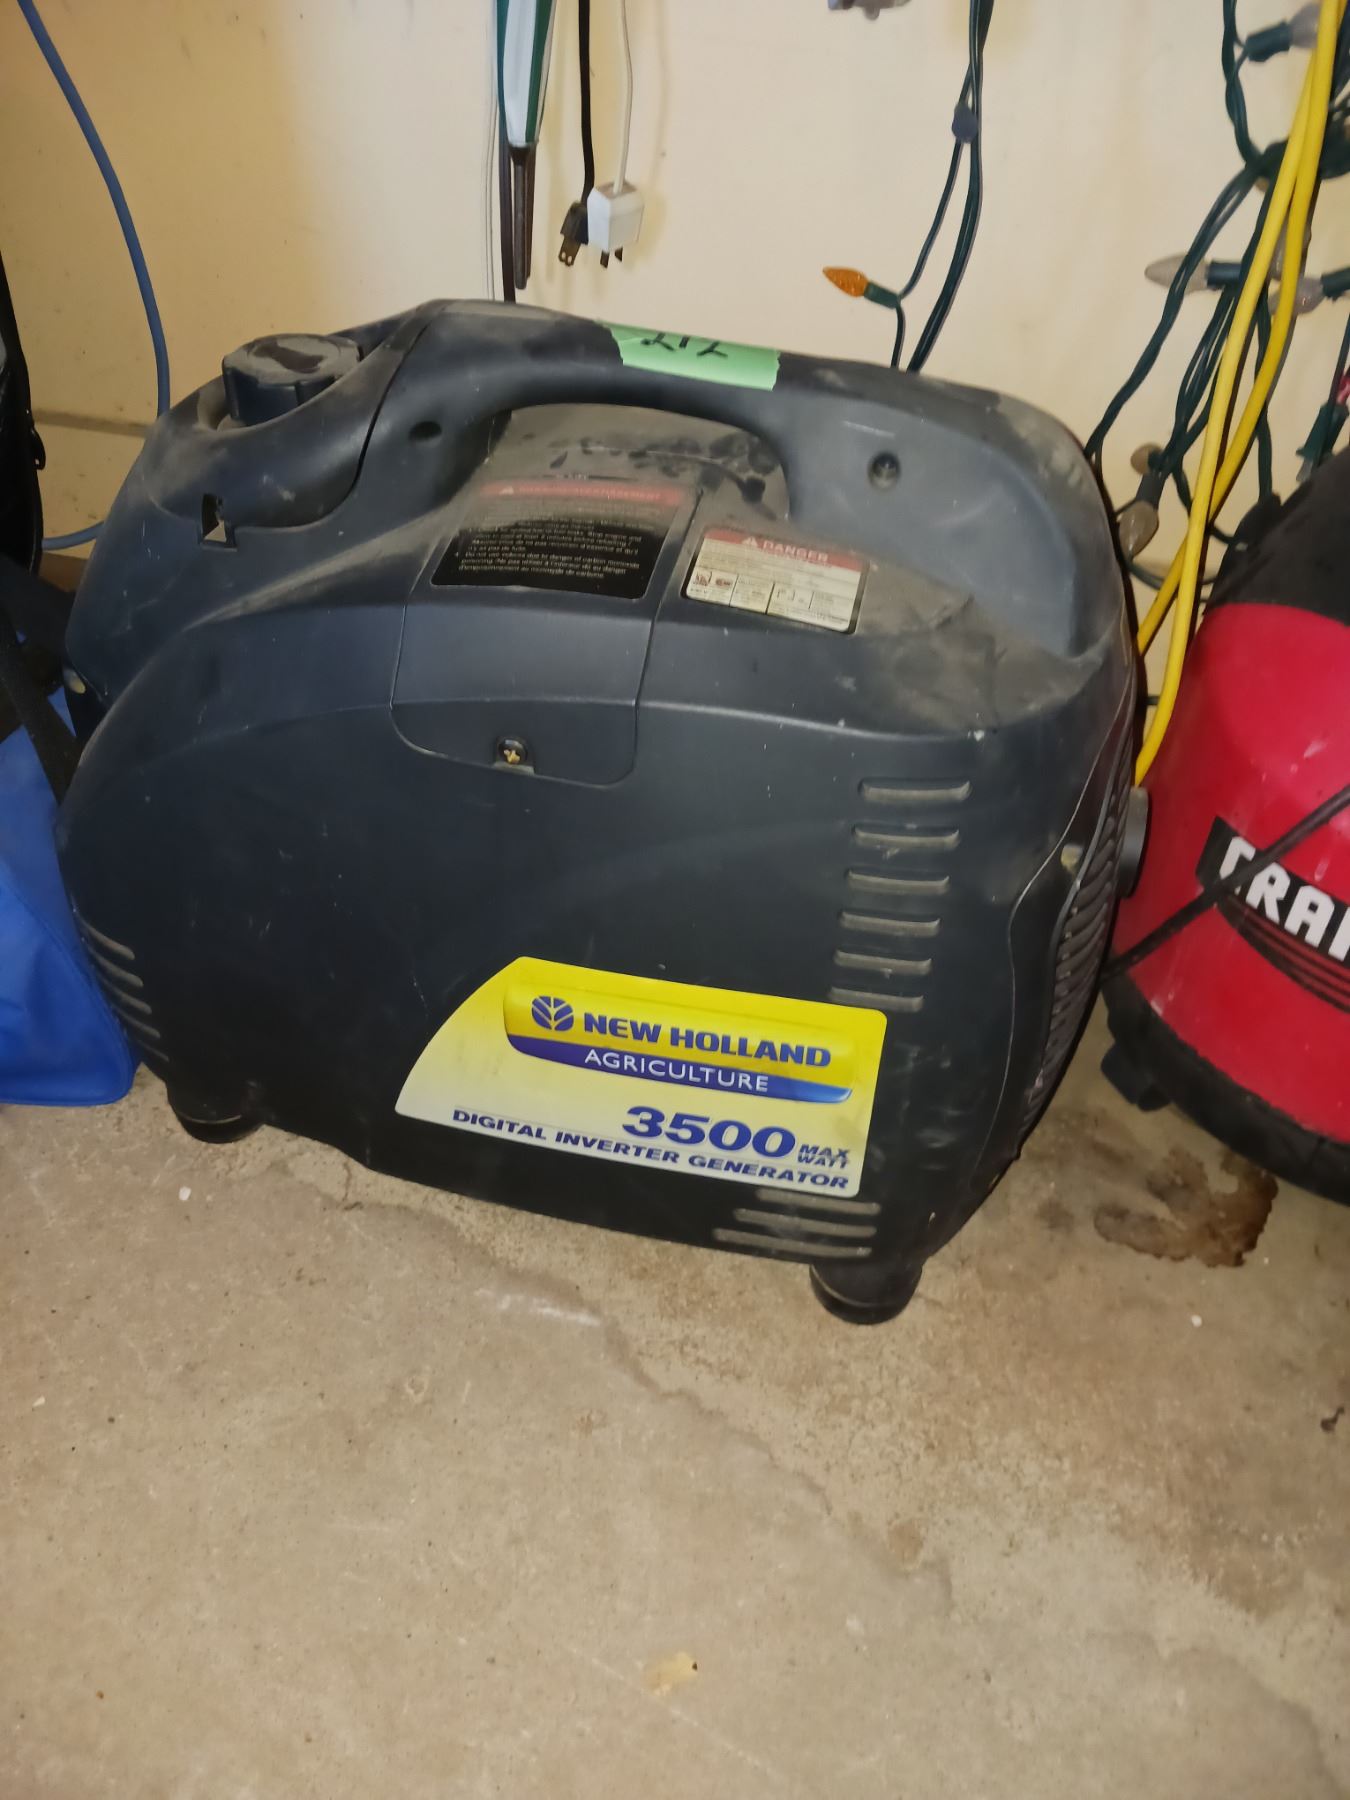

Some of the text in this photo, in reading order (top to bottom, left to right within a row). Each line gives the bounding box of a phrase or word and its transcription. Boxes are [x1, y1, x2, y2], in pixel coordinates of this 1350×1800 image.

[763, 539, 828, 561] DANGER
[584, 1013, 832, 1068] NEW HOLLAND
[585, 1048, 769, 1093] AGRICULTURE
[452, 1109, 849, 1190] DIGITAL INVERTER GENERATOR
[622, 1106, 796, 1159] 3500
[799, 1144, 850, 1160] MAX
[797, 1153, 850, 1170] WATT
